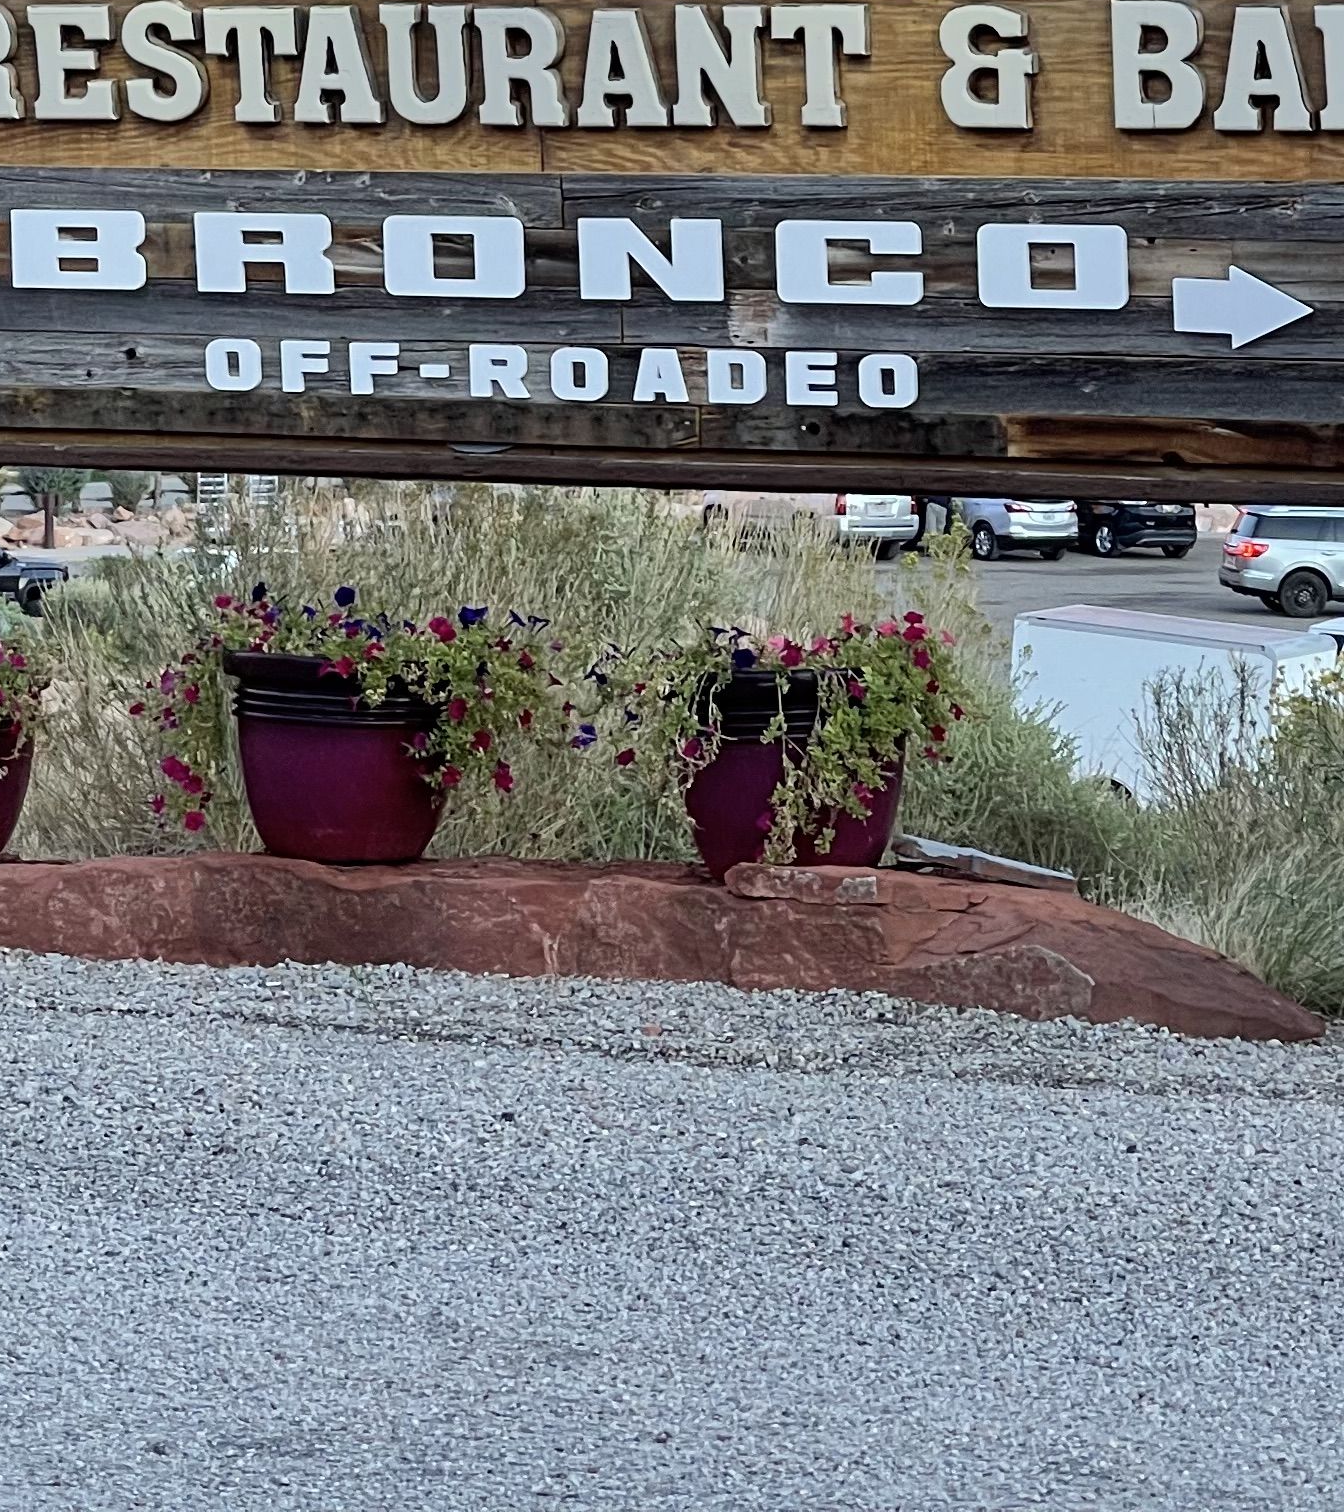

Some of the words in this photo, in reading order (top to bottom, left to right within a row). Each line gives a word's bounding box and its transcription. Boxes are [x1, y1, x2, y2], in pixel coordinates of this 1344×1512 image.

[938, 3, 1038, 131] &
[10, 208, 1130, 311] BRONCO
[204, 338, 919, 409] OFF-ROADEO
